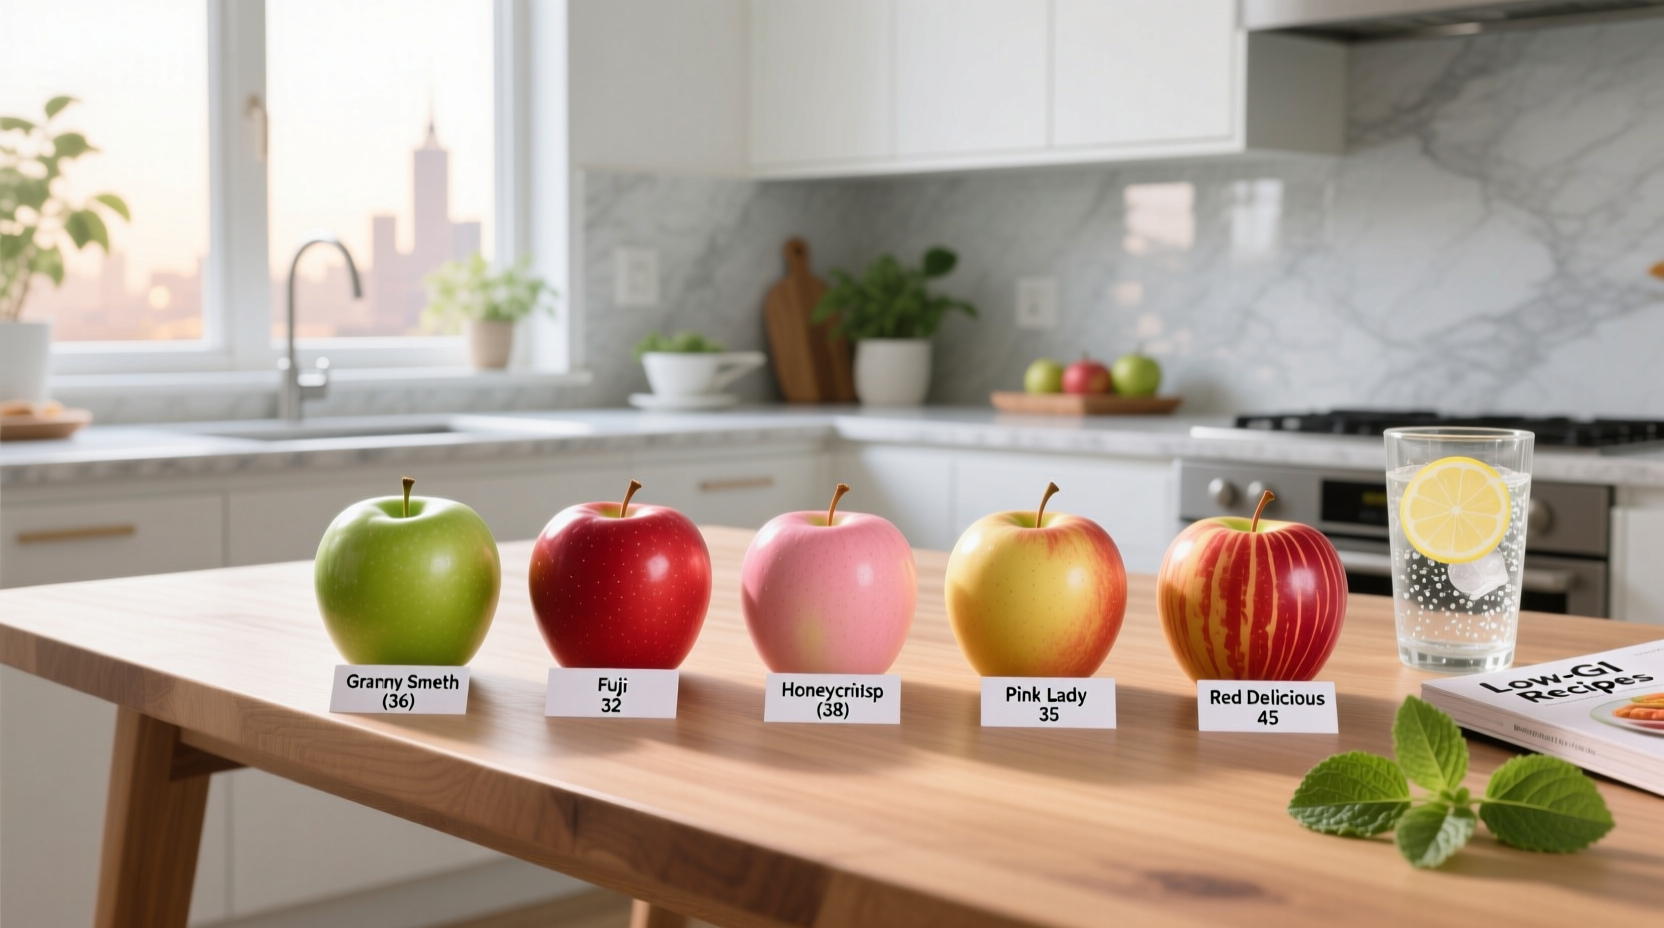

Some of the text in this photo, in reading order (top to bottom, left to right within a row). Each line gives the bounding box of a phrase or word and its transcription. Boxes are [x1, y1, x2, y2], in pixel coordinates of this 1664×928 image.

[346, 673, 459, 691] Granny Smeth
[598, 677, 628, 697] Fuji
[1479, 661, 1624, 694] Low-GI
[1006, 686, 1087, 707] Pink Lady
[1210, 689, 1326, 706] Red Delicious
[1515, 673, 1654, 703] Recipes
[382, 692, 415, 711] (36)
[601, 697, 622, 713] 32
[816, 701, 850, 720] (38)
[1039, 706, 1060, 722] 35
[1257, 709, 1279, 726] 45
